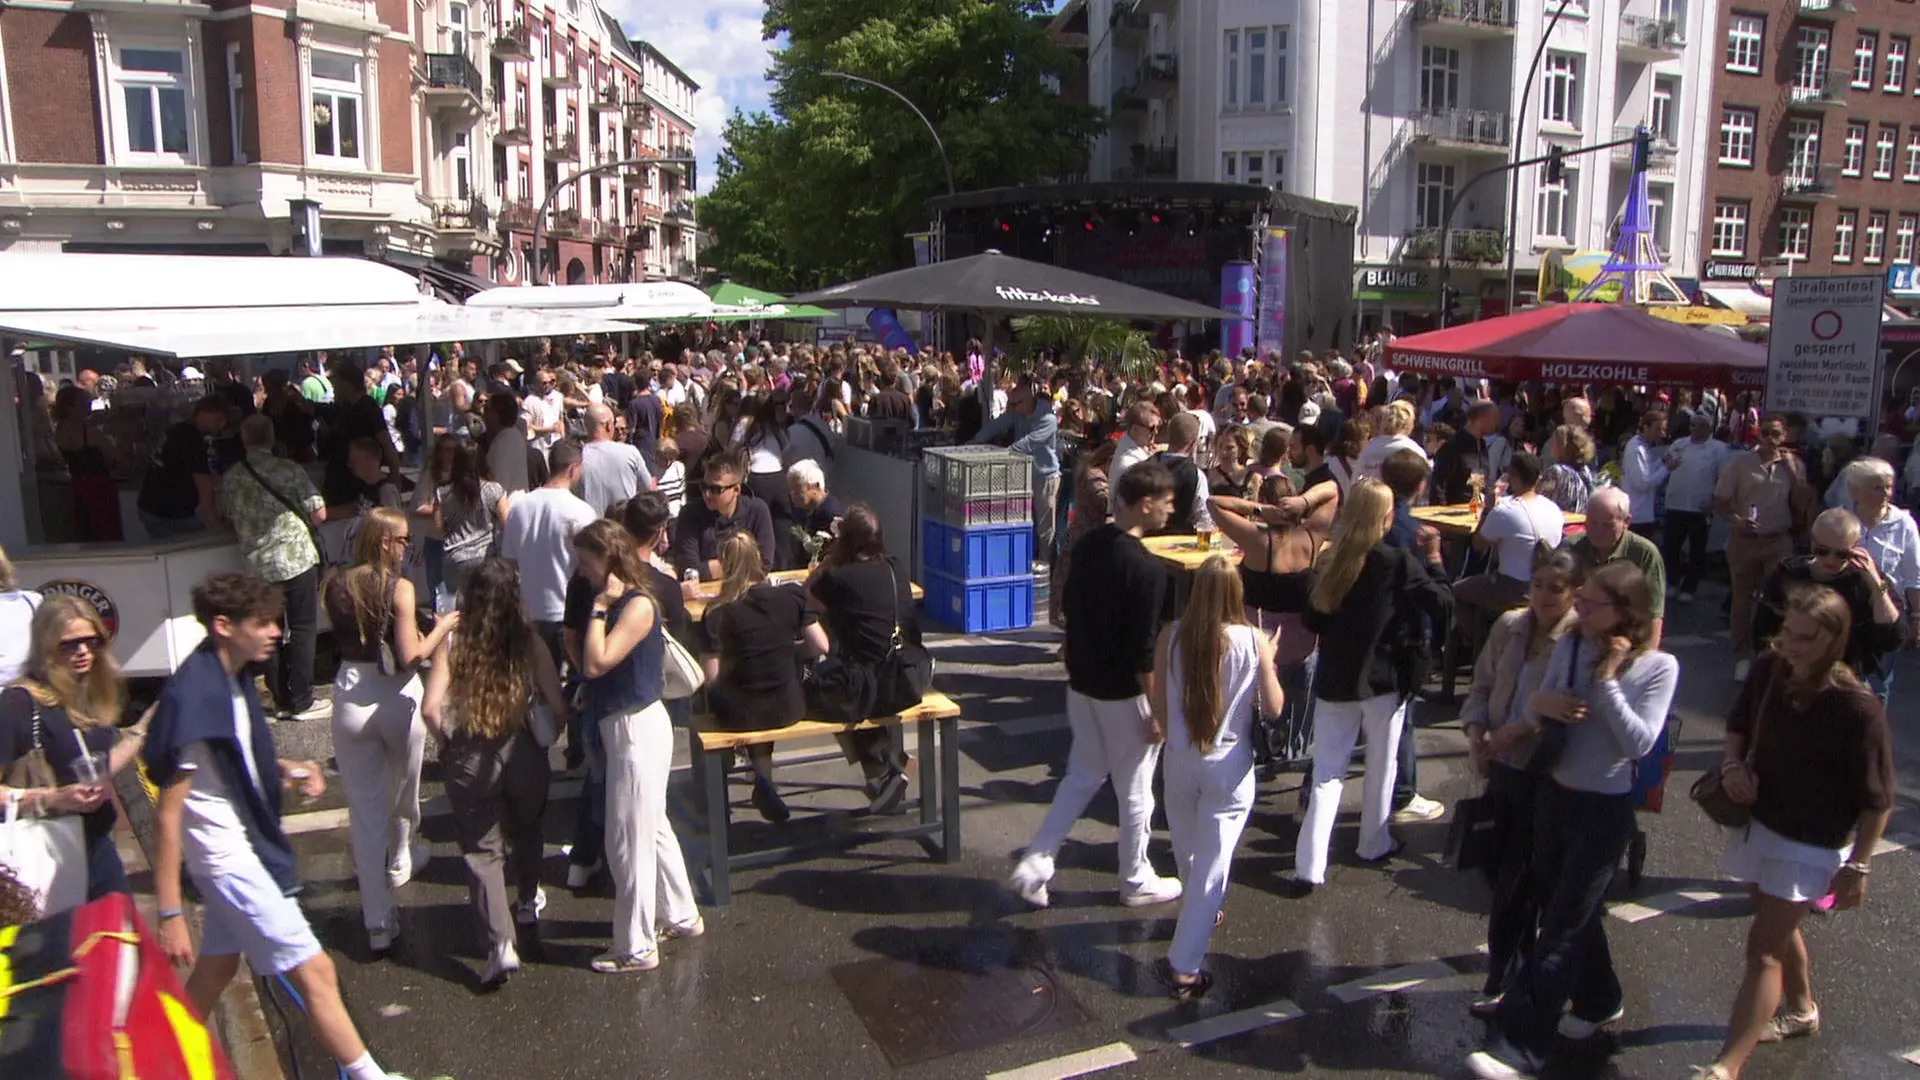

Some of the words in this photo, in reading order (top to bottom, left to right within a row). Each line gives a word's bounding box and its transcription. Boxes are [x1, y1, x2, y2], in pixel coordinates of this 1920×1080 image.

[1367, 269, 1418, 288] BLUME
[1789, 279, 1874, 294] Straßenfest
[1794, 341, 1856, 356] gesperrt
[1391, 352, 1486, 374] SCHWENKGRILL
[1541, 363, 1648, 380] HOLZKOHLE
